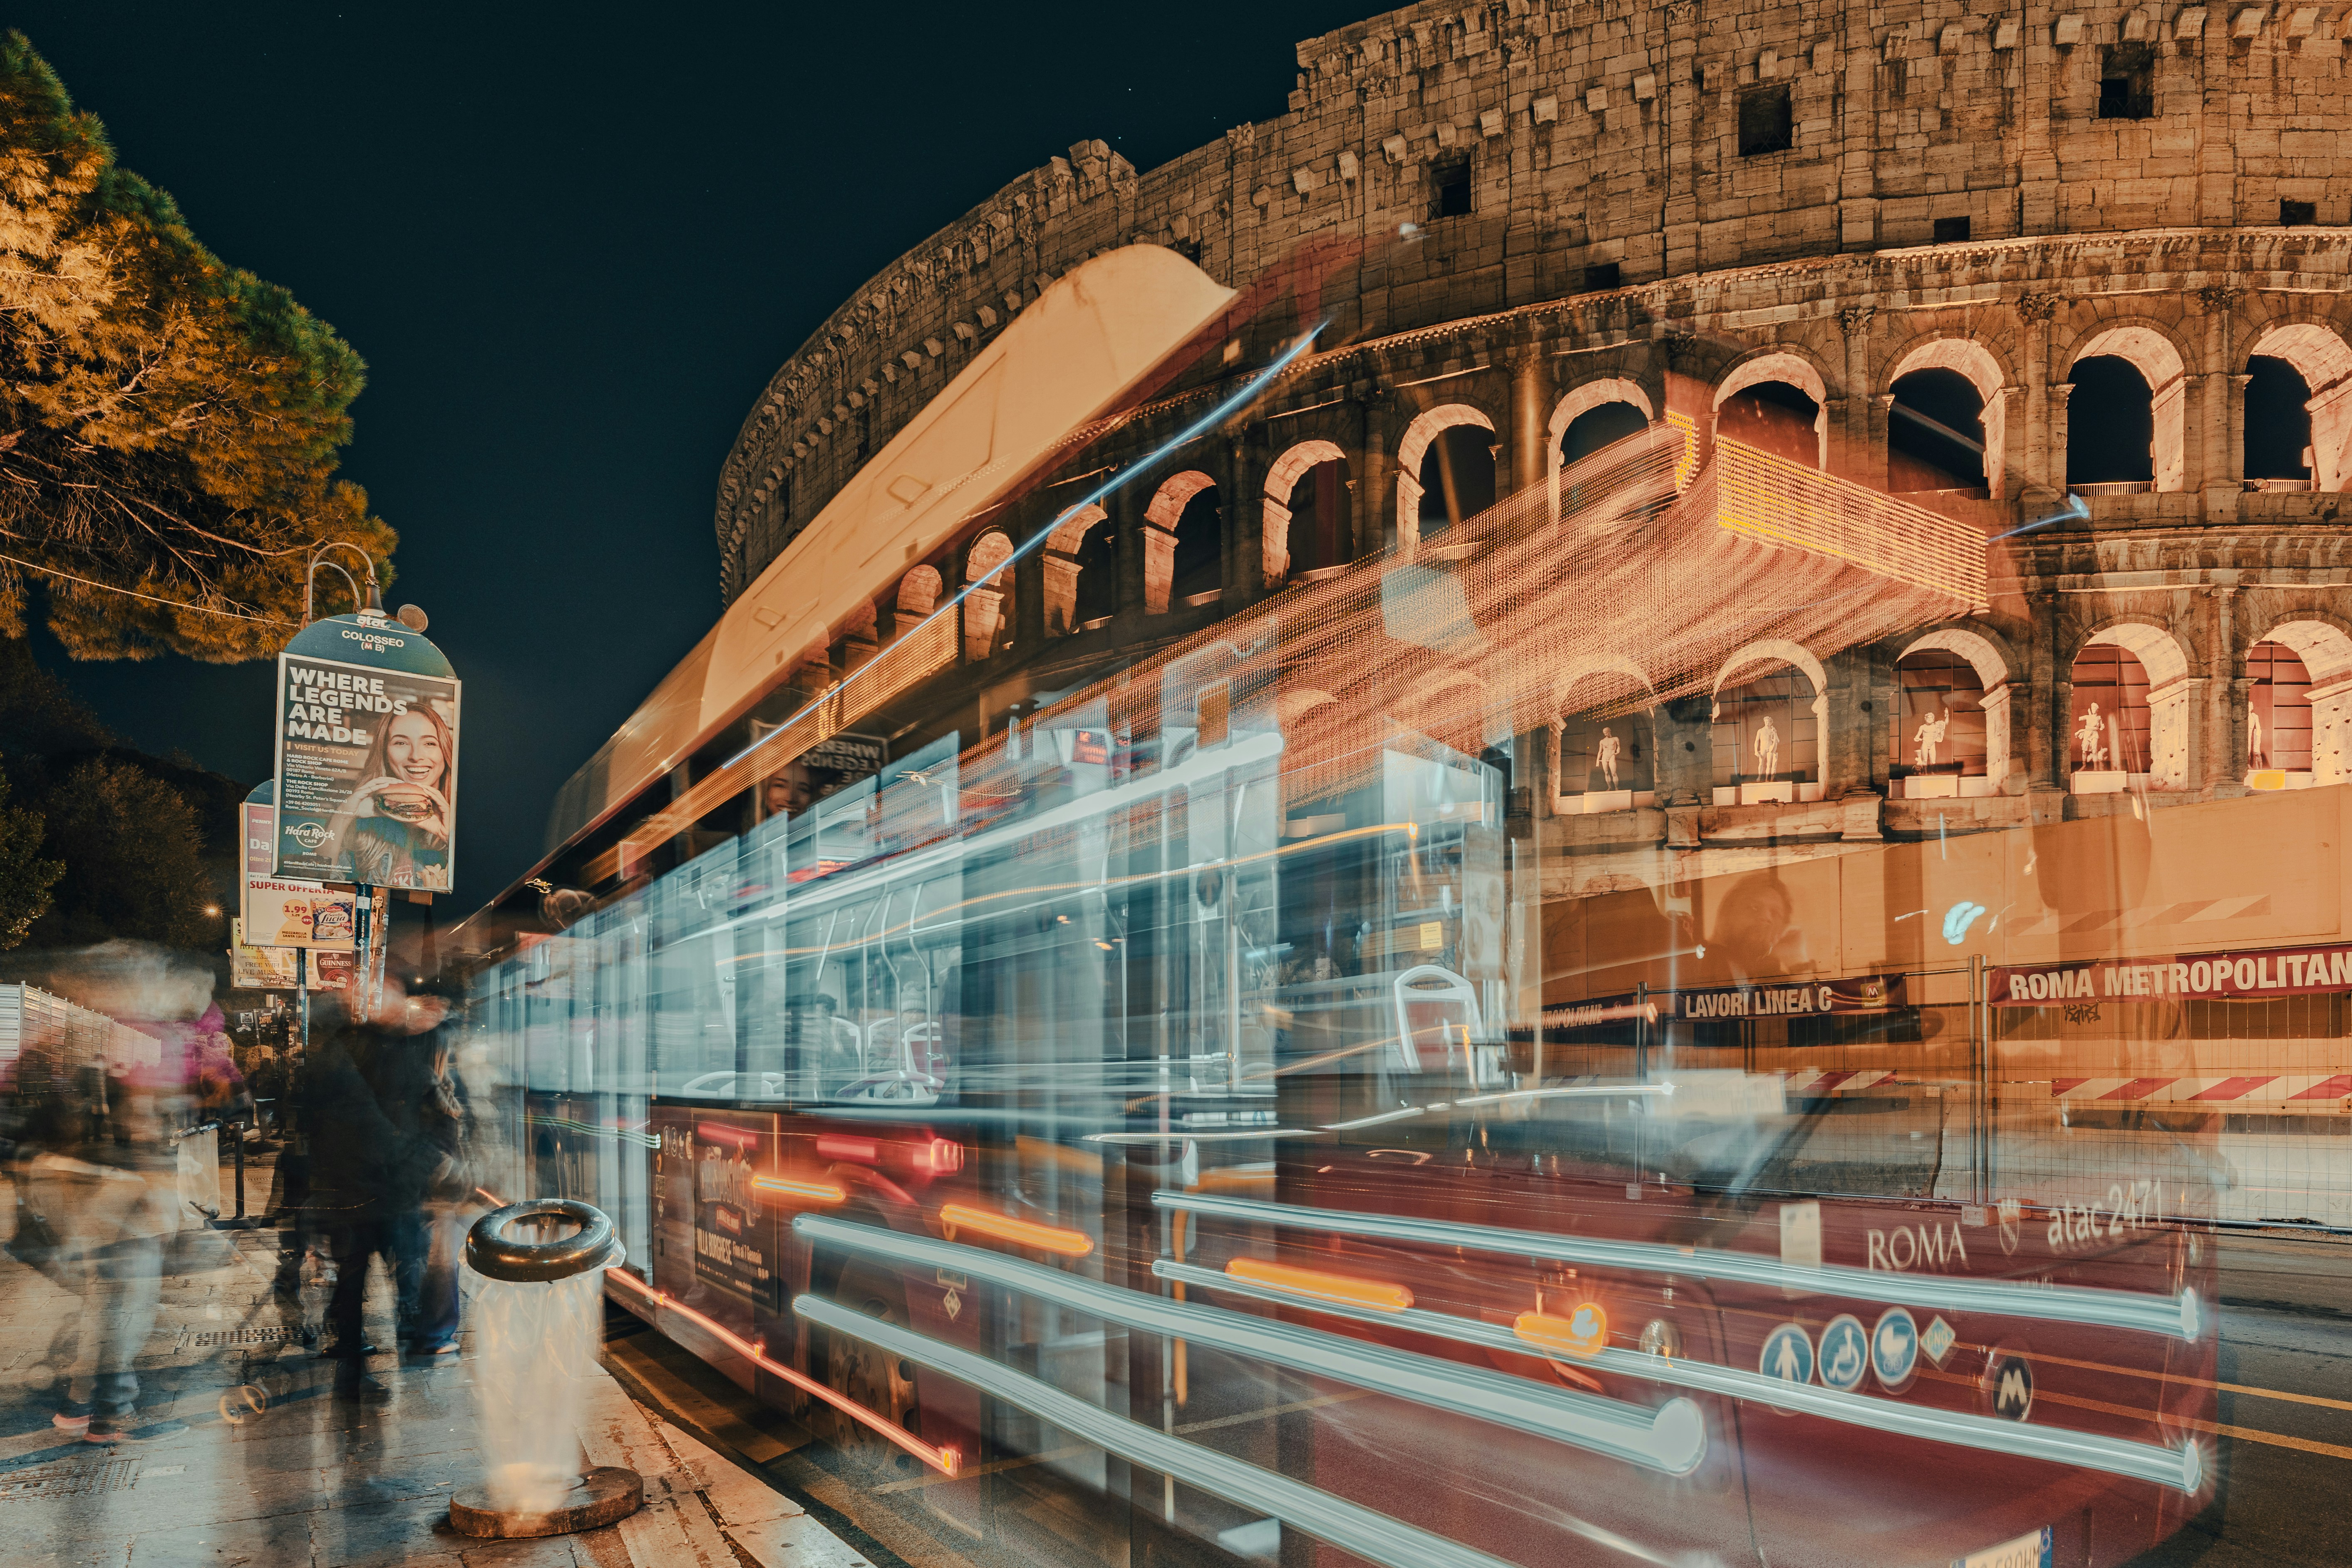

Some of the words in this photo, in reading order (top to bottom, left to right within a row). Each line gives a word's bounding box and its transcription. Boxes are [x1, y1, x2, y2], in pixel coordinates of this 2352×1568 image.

[341, 630, 404, 648] COLOSSEO
[375, 643, 385, 654] B)
[289, 666, 384, 696] WHERE
[290, 684, 408, 716] LEGENDS
[288, 703, 342, 725] ARE
[288, 720, 367, 746] MADE
[330, 748, 359, 757] TODAY
[285, 826, 311, 836] Hard
[311, 828, 335, 840] Rock
[250, 881, 285, 891] SUPER
[284, 905, 307, 913] 1.99
[321, 913, 346, 923] Lucia
[320, 959, 351, 967] GUINNESS
[2009, 968, 2096, 1000] ROMA
[1685, 992, 1748, 1018] LAVORI
[1754, 987, 1813, 1015] LINEA
[1818, 986, 1832, 1011] C
[2047, 1198, 2104, 1248] atac
[697, 1228, 709, 1257] VILLA
[708, 1232, 732, 1266] BORGHESE
[1867, 1220, 1968, 1270] ROMA
